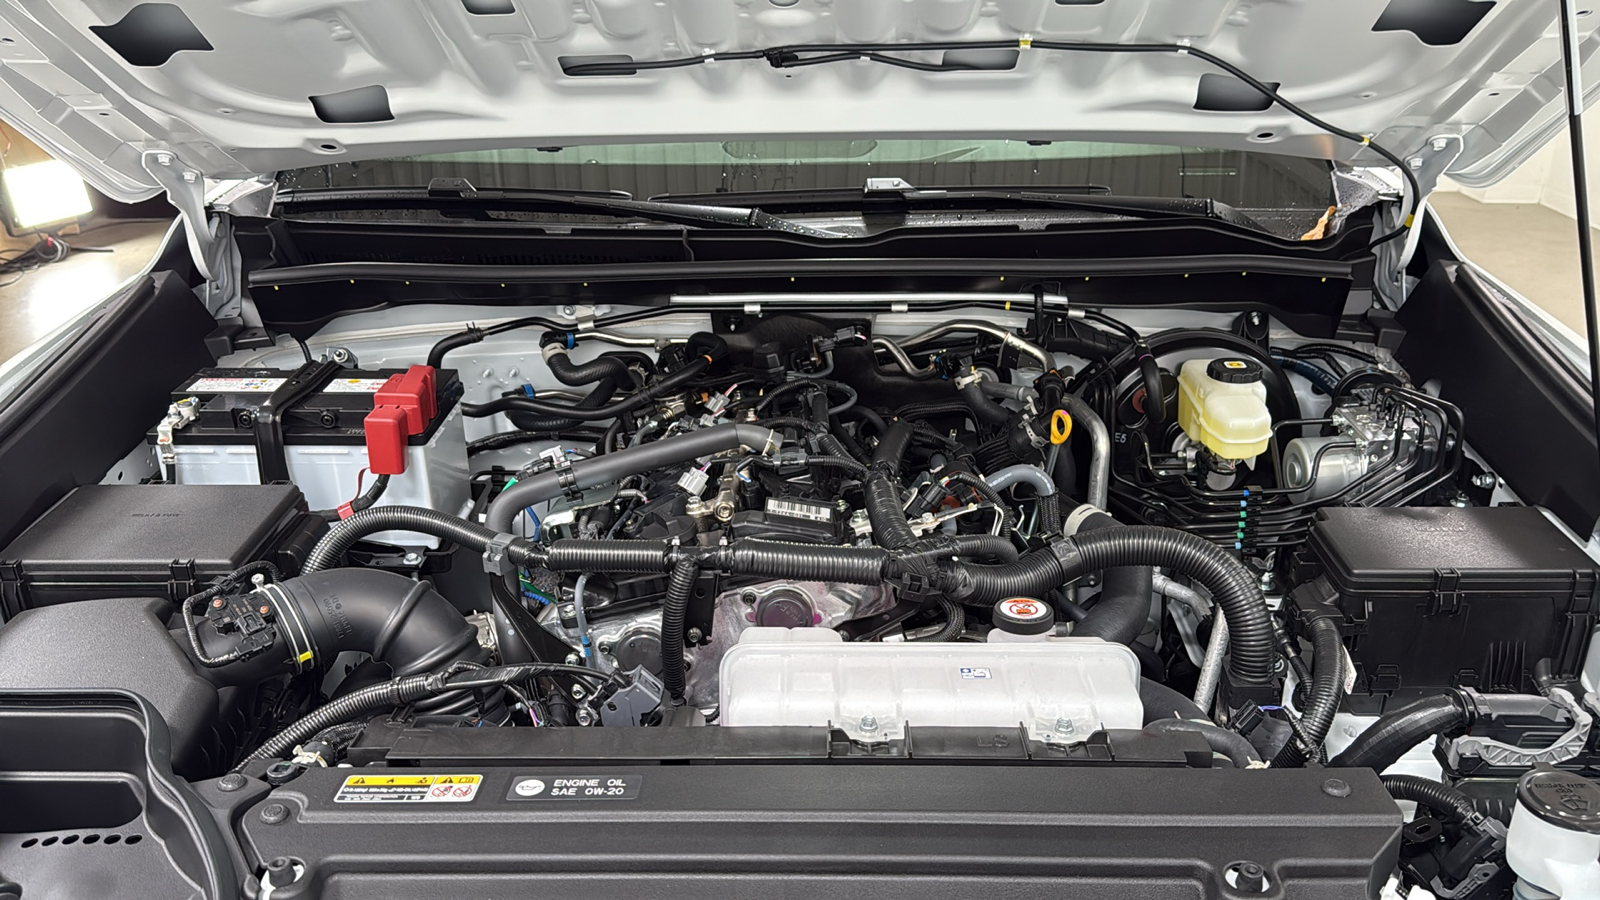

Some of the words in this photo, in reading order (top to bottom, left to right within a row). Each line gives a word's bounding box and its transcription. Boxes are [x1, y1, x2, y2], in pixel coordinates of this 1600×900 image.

[553, 779, 600, 787] ENGINE
[606, 779, 627, 787] OIL
[550, 788, 578, 796] SAE
[584, 788, 624, 796] 0W-20
